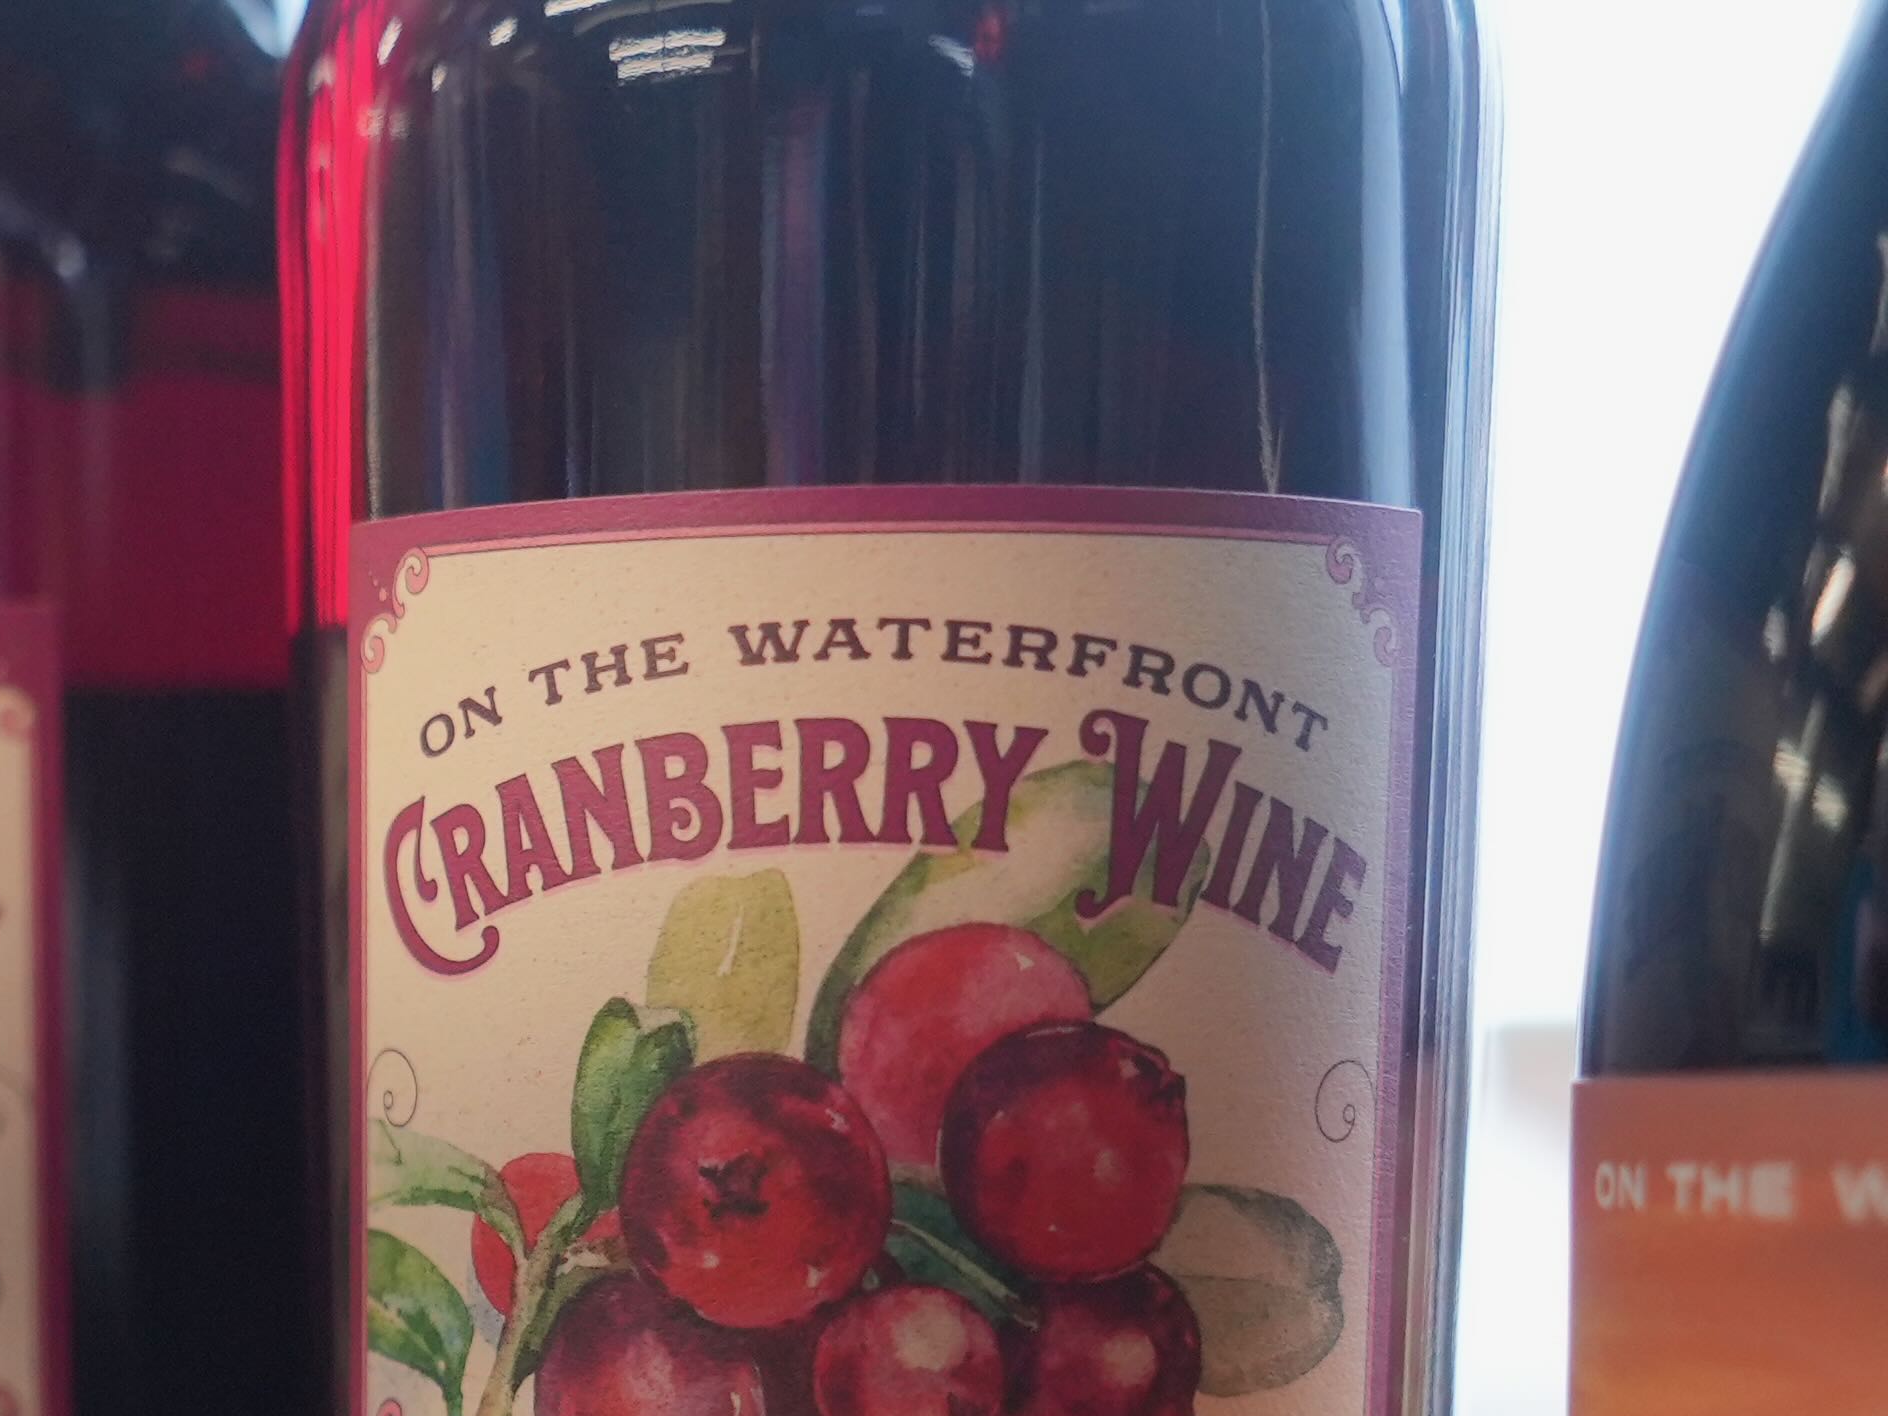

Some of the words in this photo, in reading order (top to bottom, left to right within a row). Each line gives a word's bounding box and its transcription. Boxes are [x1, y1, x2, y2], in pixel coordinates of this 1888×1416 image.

[420, 686, 504, 757] ON
[528, 633, 690, 706] THE
[732, 617, 1329, 752] WATERFRONT
[384, 716, 1050, 976] CRANBERRY
[1078, 708, 1369, 973] WINE
[1596, 1161, 1648, 1211] ON
[1666, 1161, 1797, 1221] THE
